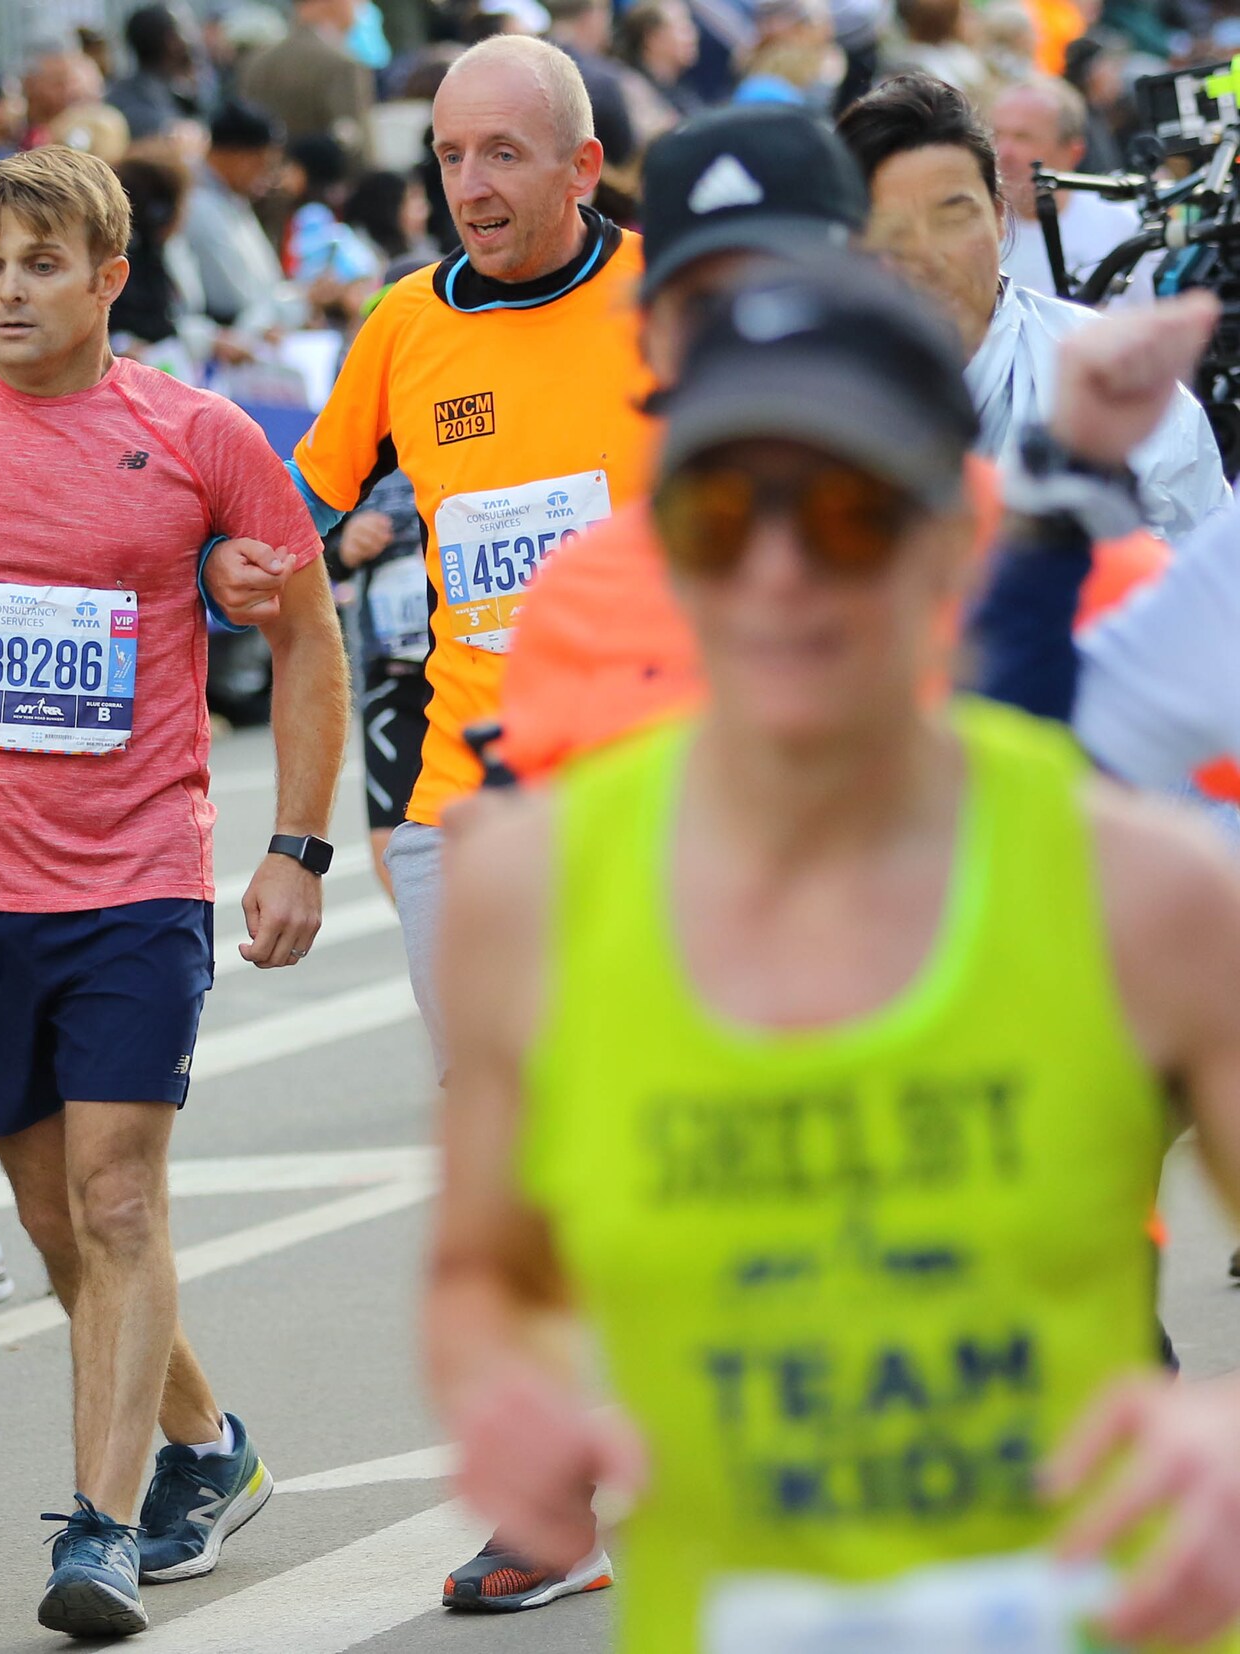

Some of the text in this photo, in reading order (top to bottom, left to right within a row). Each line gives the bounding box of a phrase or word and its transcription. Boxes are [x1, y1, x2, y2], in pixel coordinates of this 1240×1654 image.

[436, 393, 493, 422] NYCM
[444, 415, 486, 441] 2019
[482, 499, 510, 510] TATA
[466, 504, 531, 524] CONSULTANCY
[545, 508, 575, 519] TATA
[479, 519, 521, 534] SERVICES
[446, 550, 465, 598] 2019
[9, 595, 38, 605] TATA
[0, 616, 44, 628] SERVICES
[71, 619, 100, 628] TATA
[114, 616, 134, 625] VIP
[469, 612, 480, 626] 3
[98, 708, 111, 722] B
